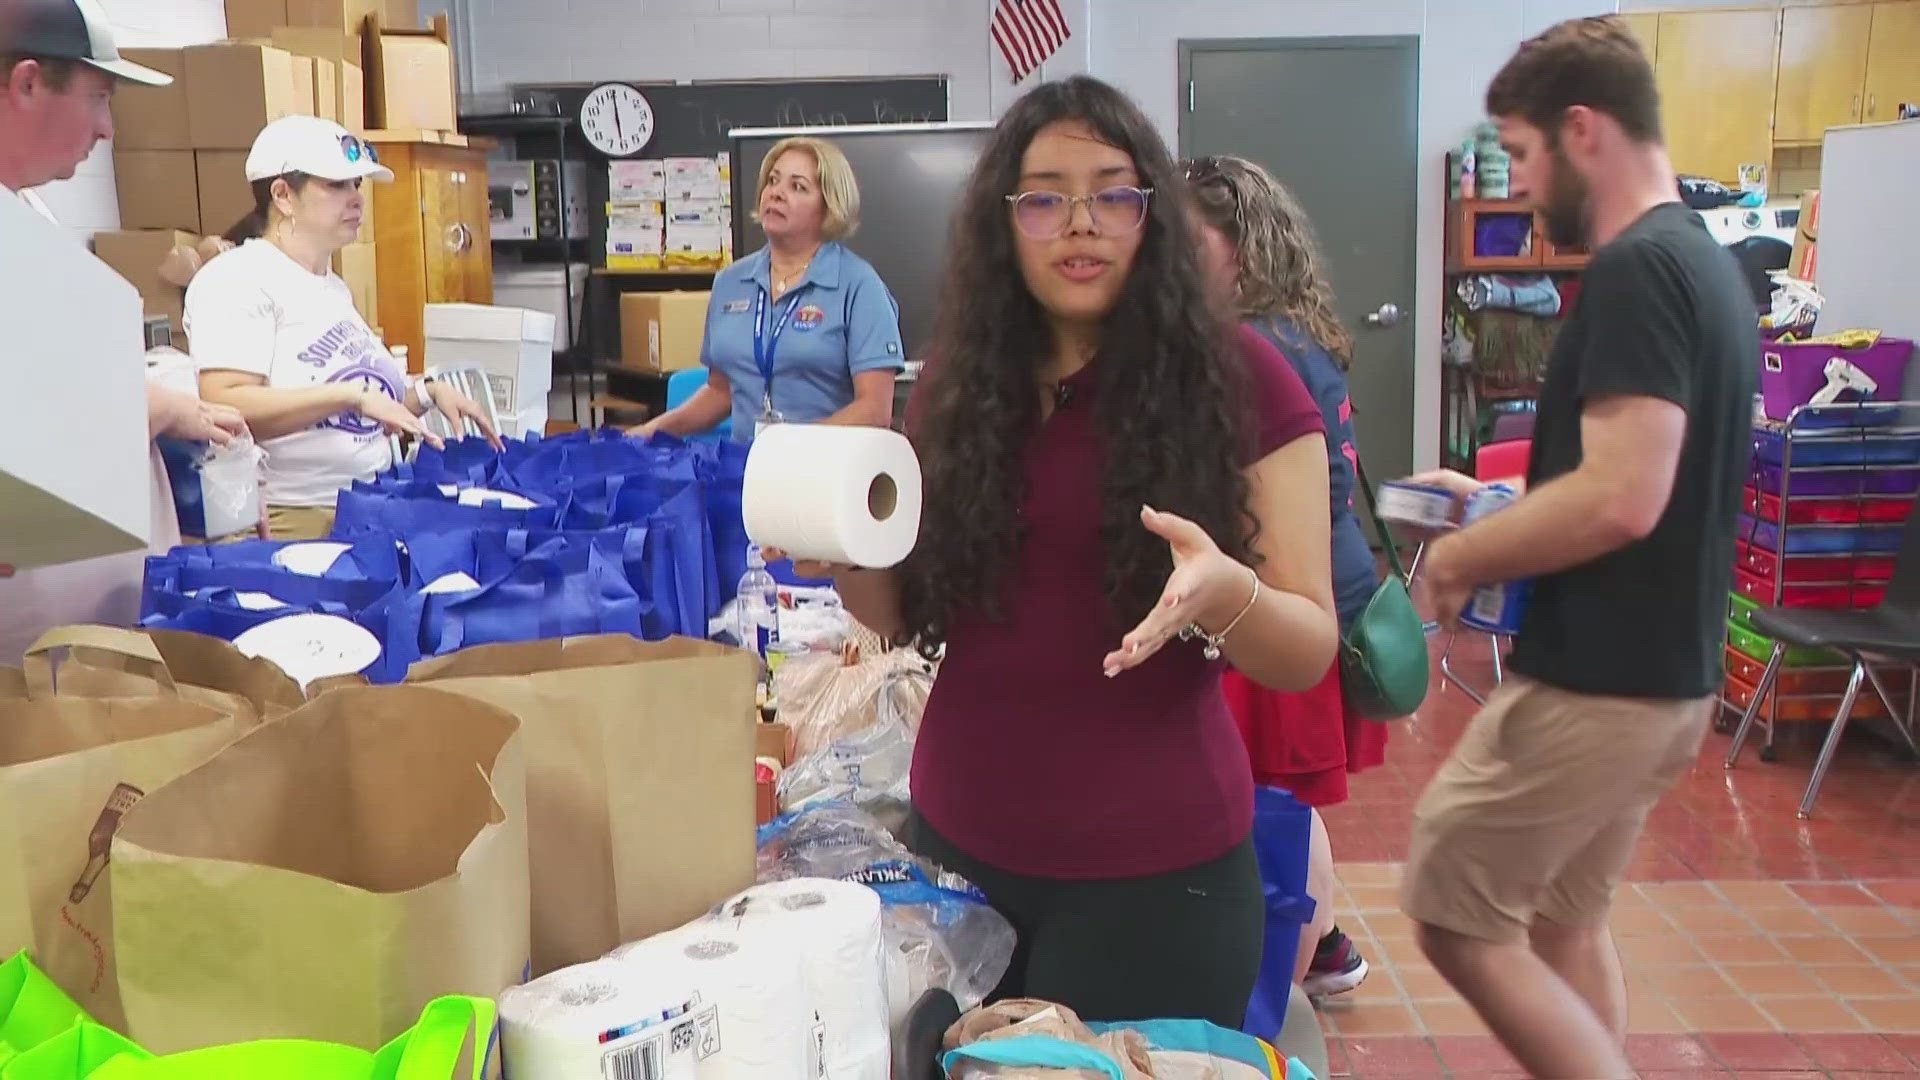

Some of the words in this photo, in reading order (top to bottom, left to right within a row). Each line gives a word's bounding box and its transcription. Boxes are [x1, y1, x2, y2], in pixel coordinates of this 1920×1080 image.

[596, 95, 604, 106] 11
[632, 99, 641, 109] 2
[588, 106, 600, 117] 10
[587, 119, 596, 129] 9
[638, 123, 646, 133] 4
[595, 131, 603, 141] 8
